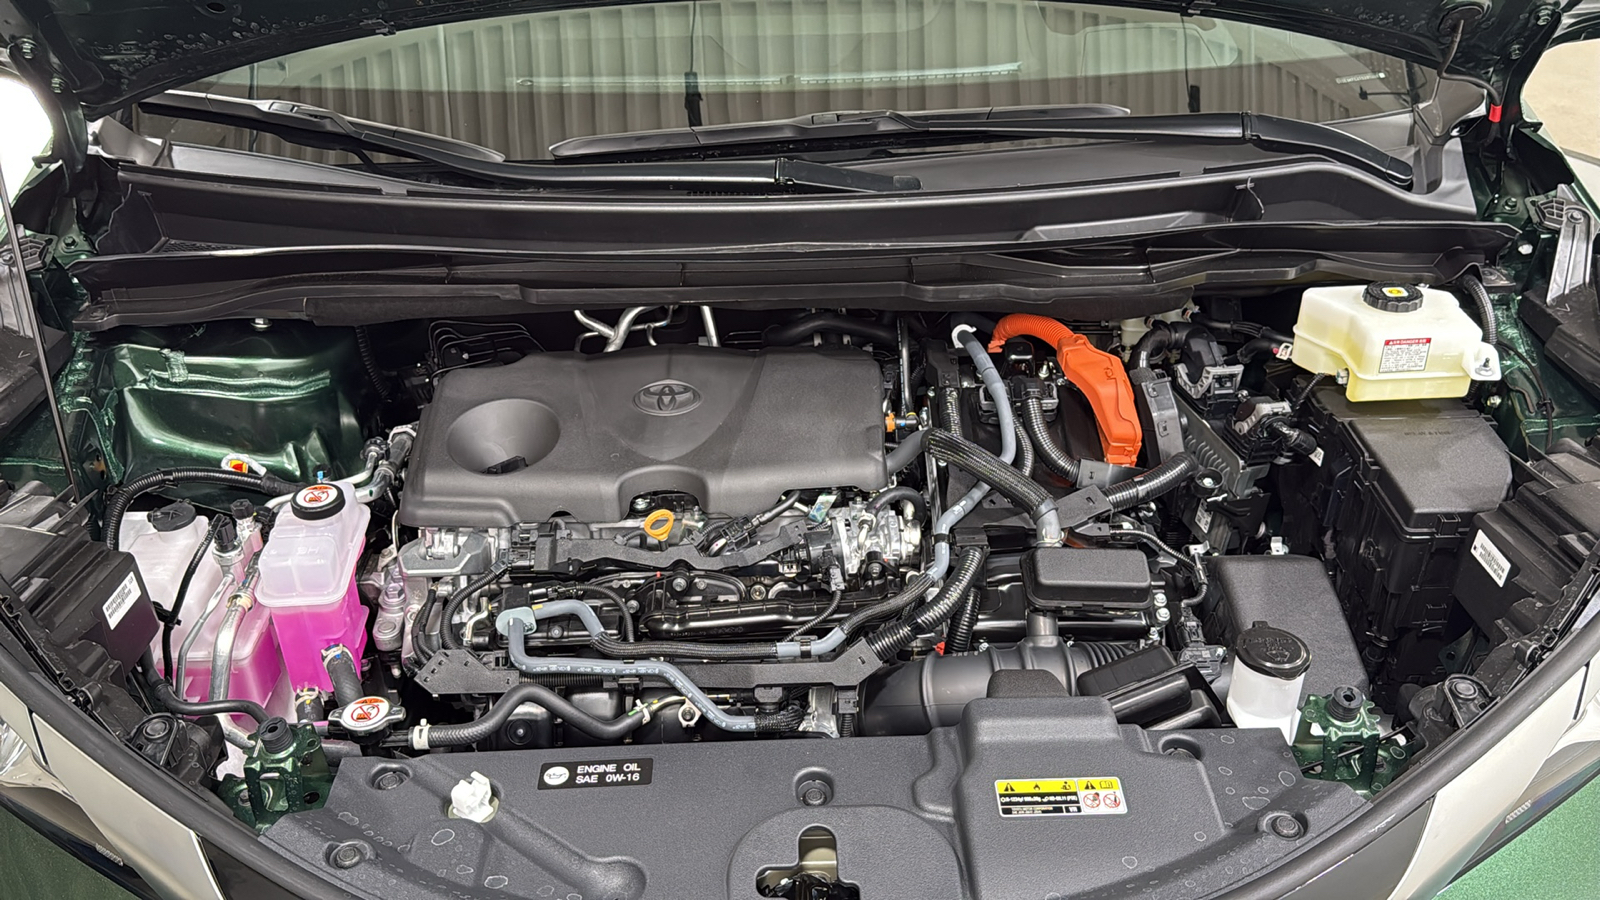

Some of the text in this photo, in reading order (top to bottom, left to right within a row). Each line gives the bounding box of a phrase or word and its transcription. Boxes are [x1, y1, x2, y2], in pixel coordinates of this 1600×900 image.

[576, 762, 641, 774] ENGINE OIL
[575, 772, 640, 784] SAE 0W-16
